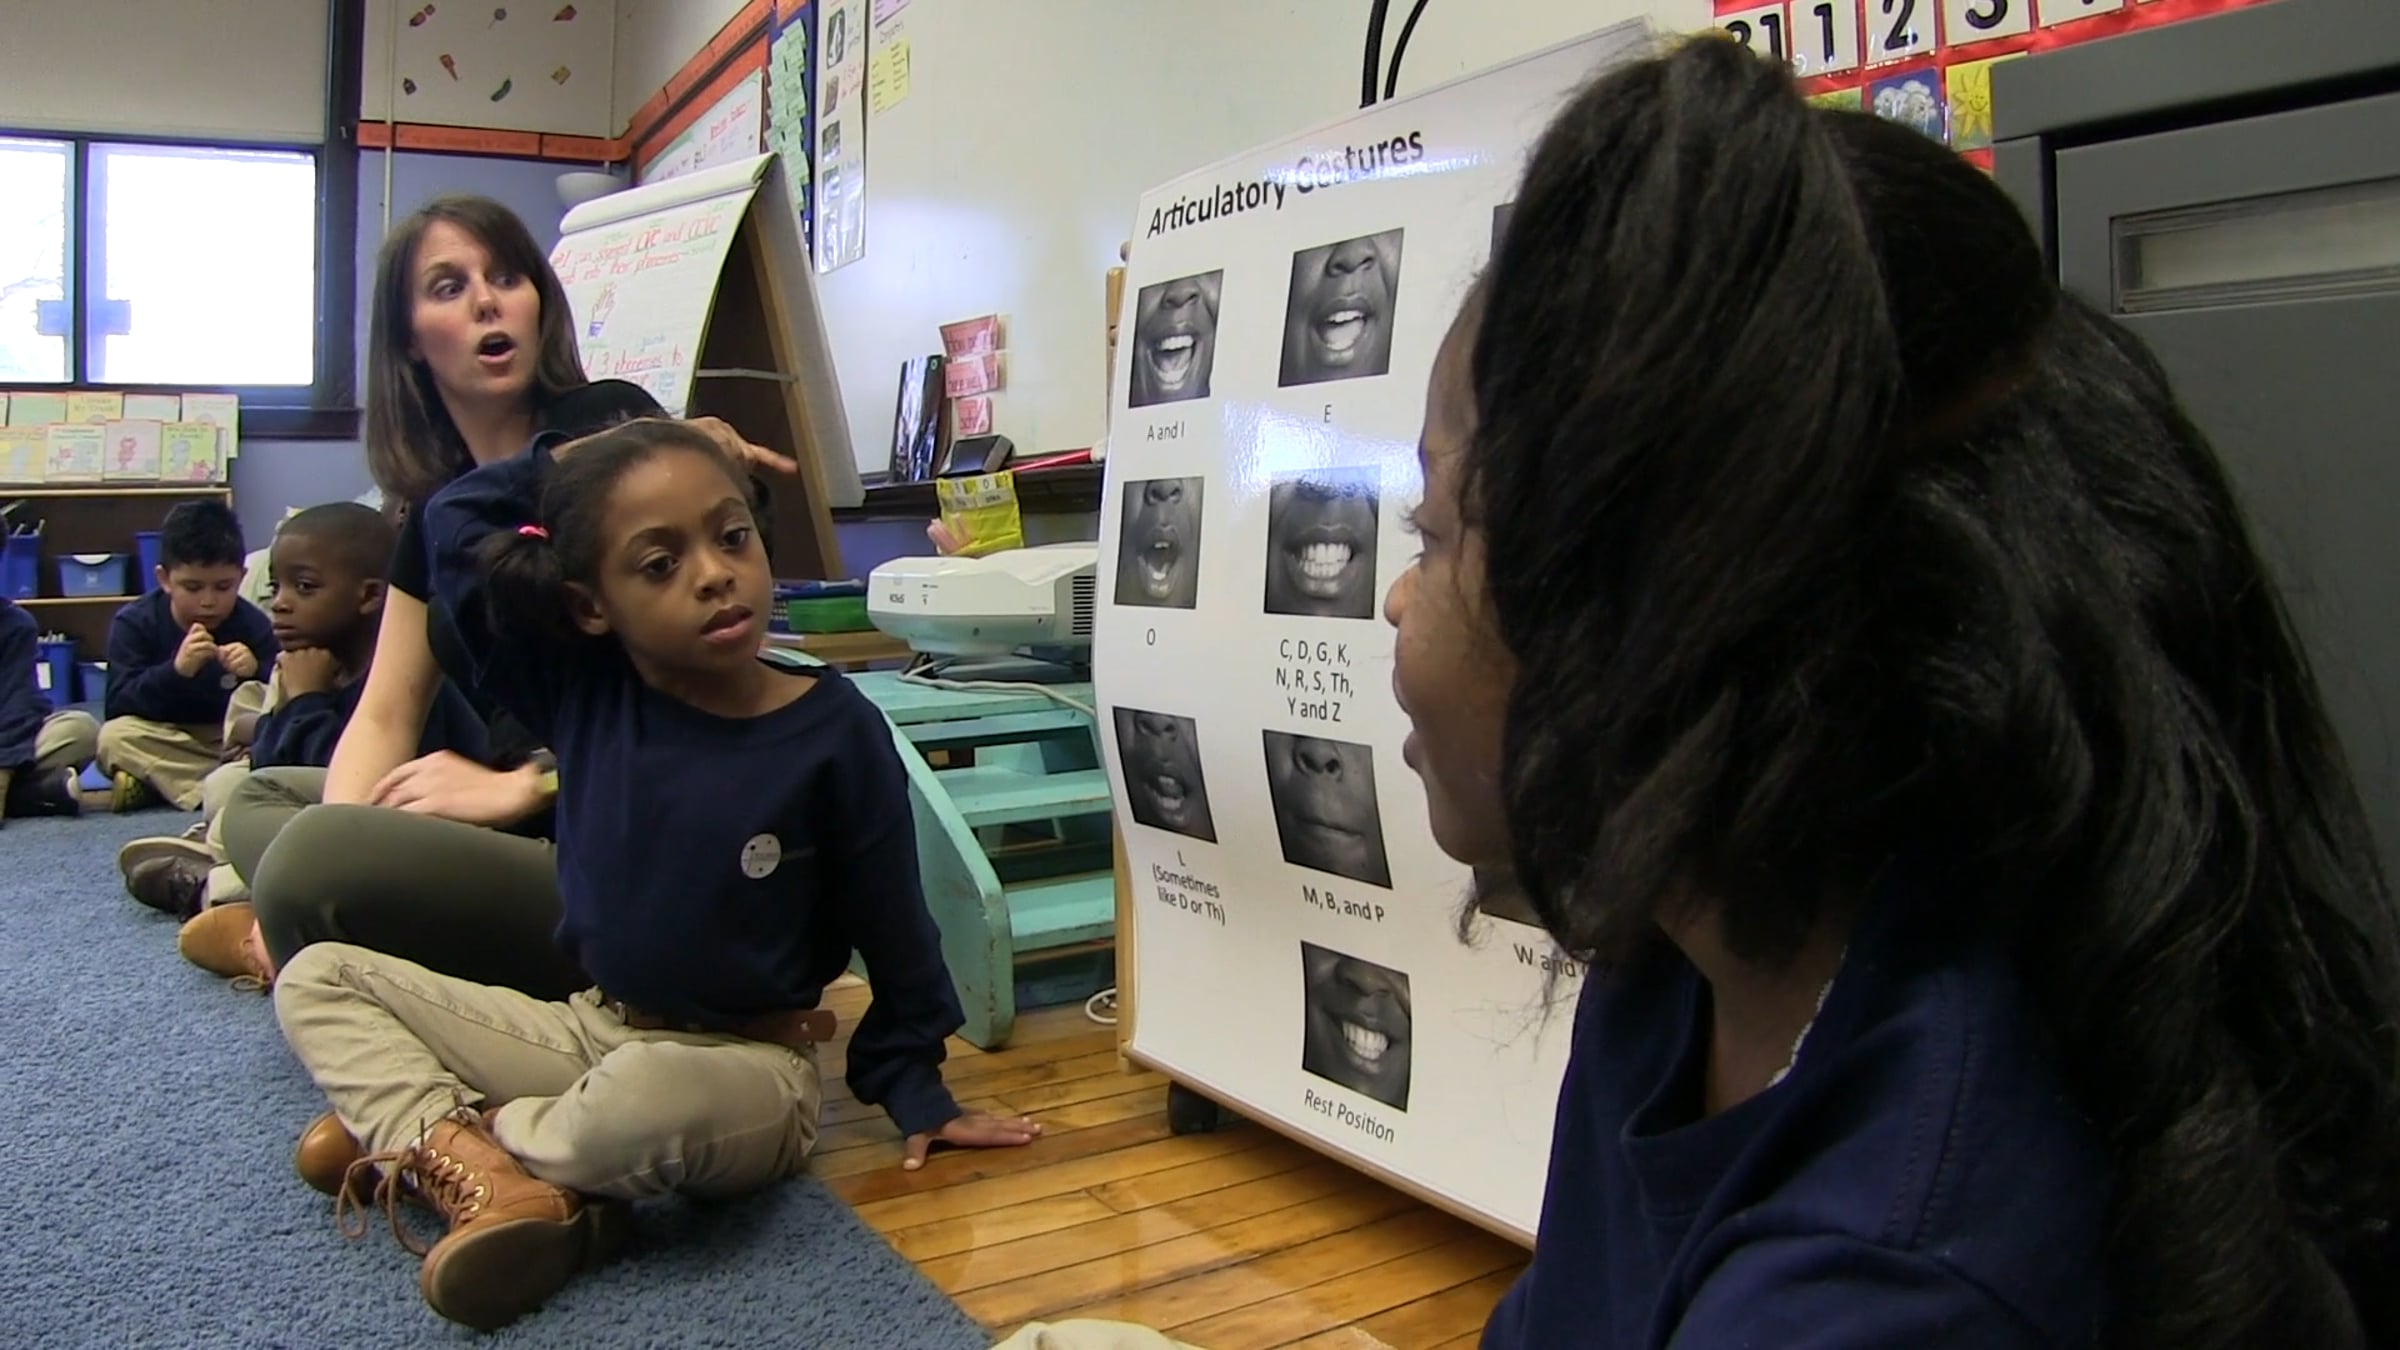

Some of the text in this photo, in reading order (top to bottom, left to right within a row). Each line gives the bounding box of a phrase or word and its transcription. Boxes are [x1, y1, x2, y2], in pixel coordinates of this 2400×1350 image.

[1813, 3, 1834, 64] 1
[1883, 0, 1918, 50] 2
[1147, 176, 1287, 239] Articulatory
[1323, 404, 1332, 424] E
[1147, 421, 1185, 441] A and I
[1146, 628, 1156, 646] O
[1280, 638, 1351, 668] C, D, G, K,
[1276, 667, 1354, 699] N, R, S, Th,
[1287, 696, 1342, 723] Y and Z
[1177, 850, 1186, 867] L
[1153, 863, 1220, 899] (Sometimes
[1157, 885, 1226, 927] like D or Th)
[1302, 884, 1385, 923] M, B, and P
[1513, 943, 1533, 966] W
[1304, 1088, 1395, 1143] Rest Position
